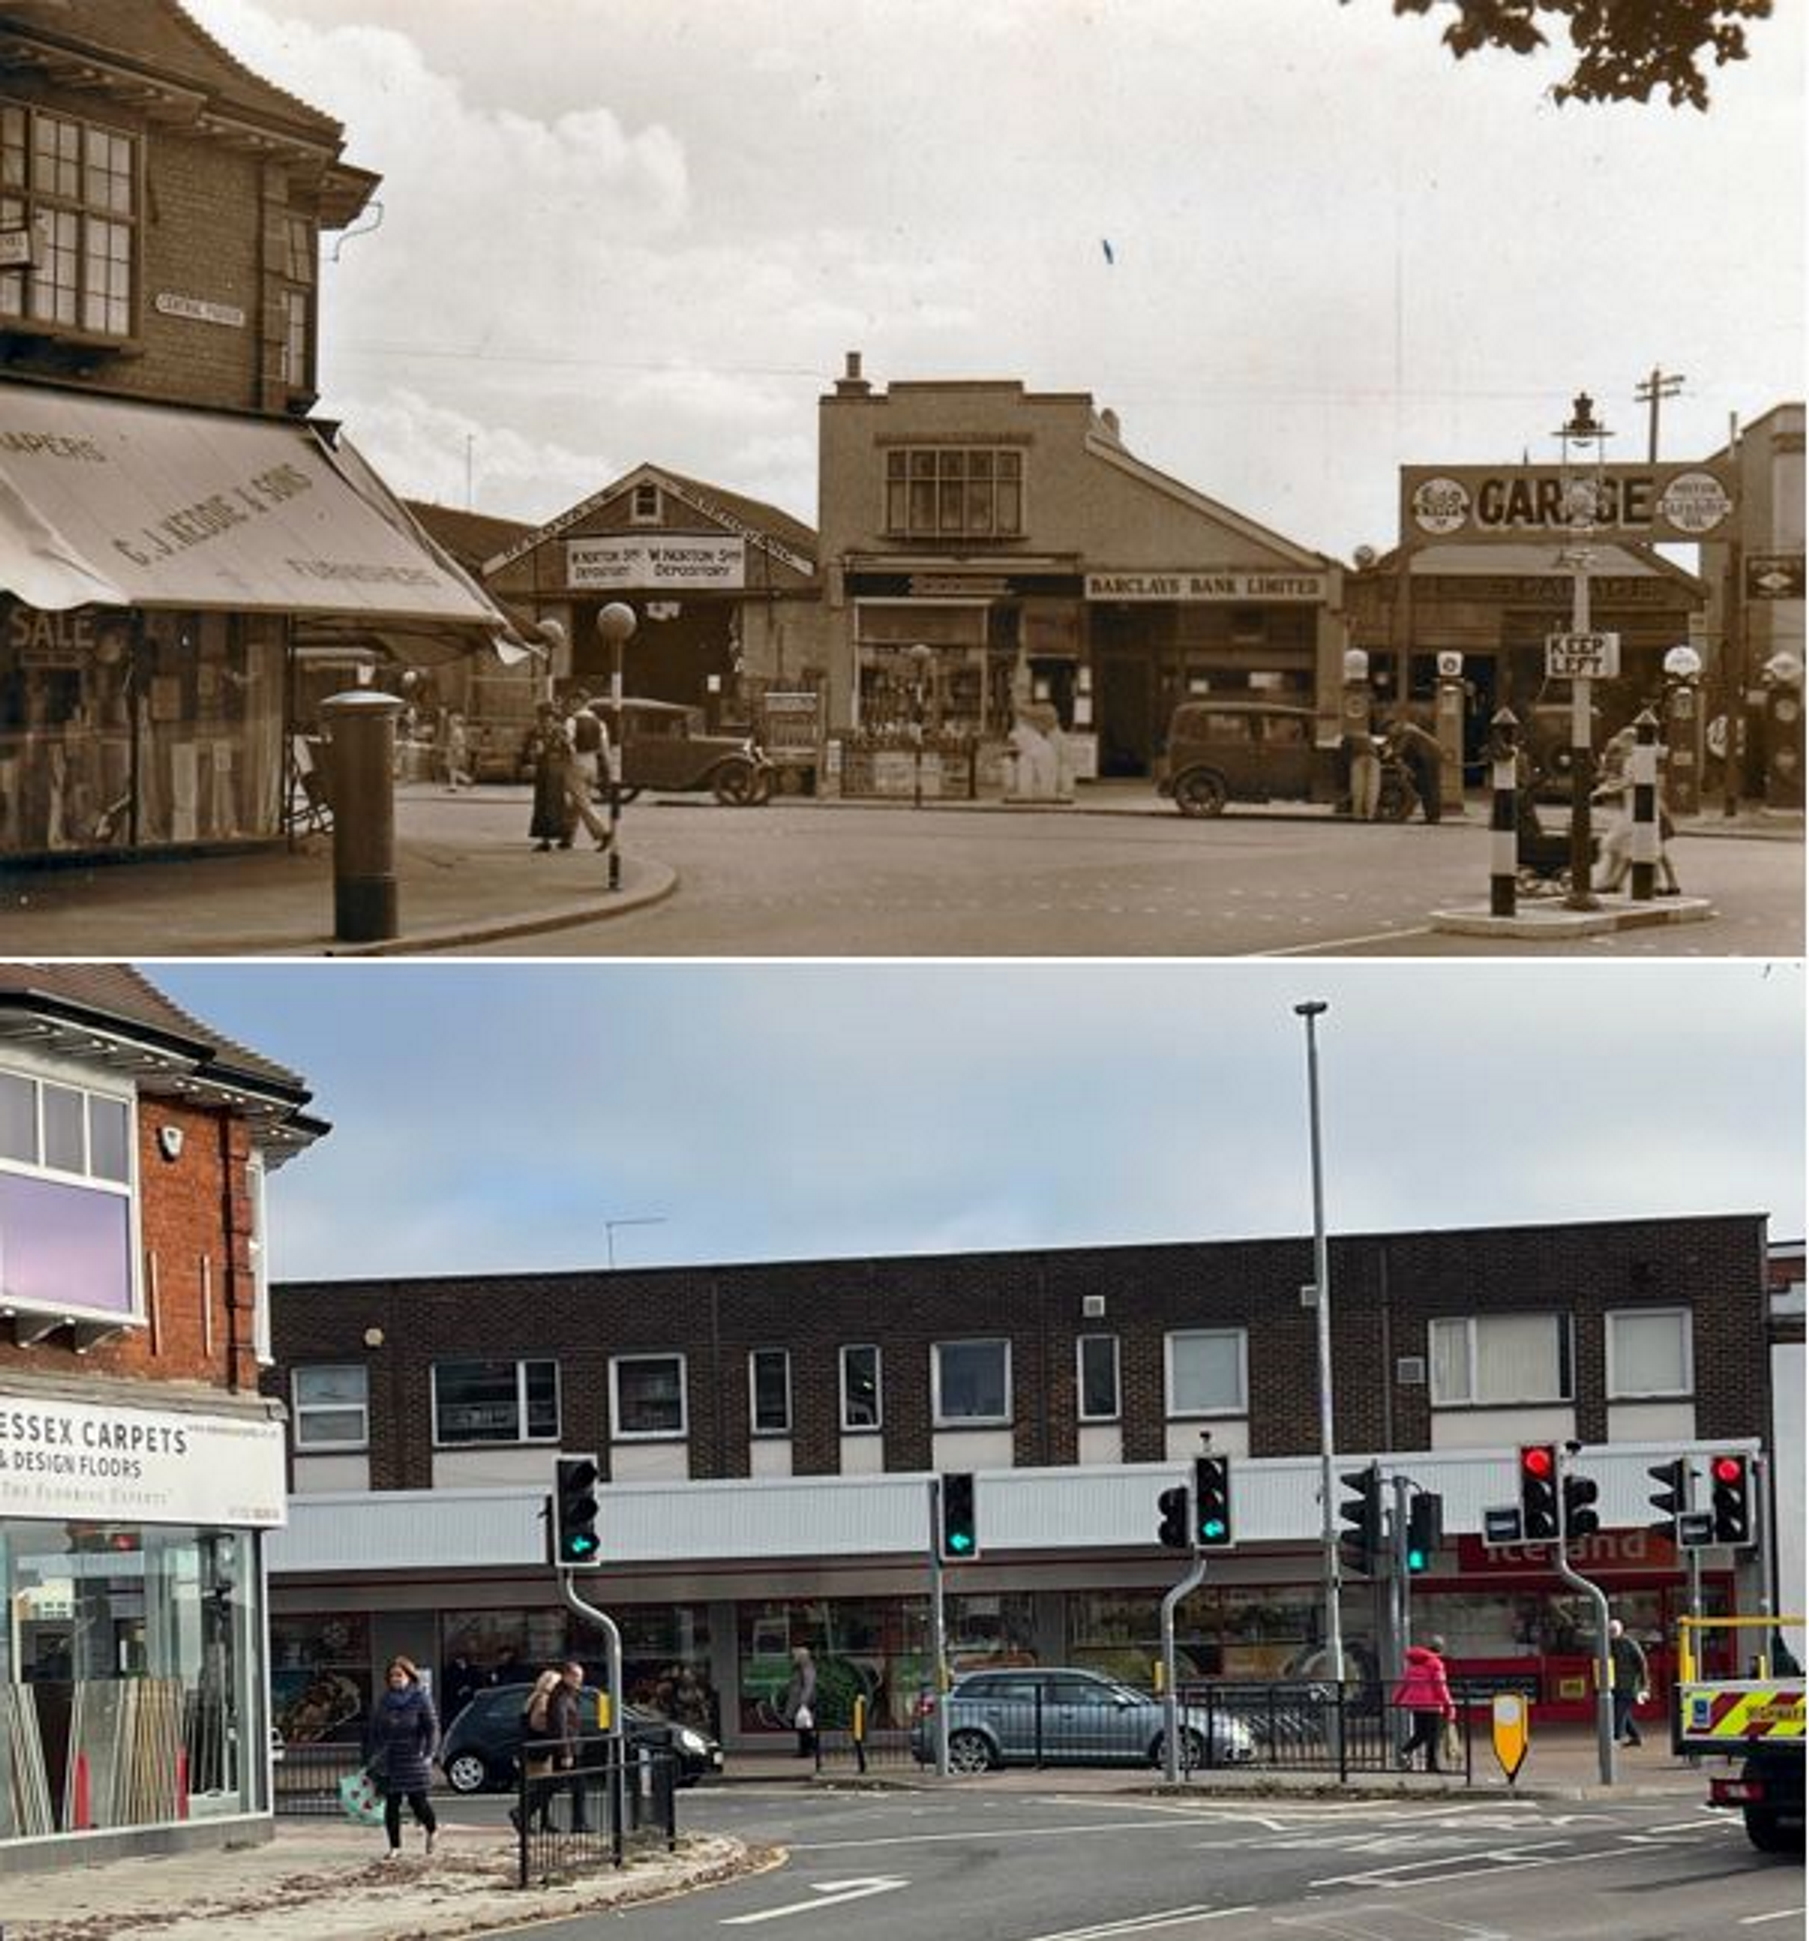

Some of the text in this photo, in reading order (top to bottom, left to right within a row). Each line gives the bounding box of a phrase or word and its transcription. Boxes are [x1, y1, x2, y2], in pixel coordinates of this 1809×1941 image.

[1479, 479, 1654, 525] GARGE
[1092, 578, 1320, 594] BARCLAYS BANK LIMITED
[9, 606, 95, 649] SALE
[1551, 639, 1604, 654] KEEP
[1551, 656, 1602, 674] LEFT
[83, 1421, 188, 1454] CARPETS
[14, 1451, 75, 1474] DESIGN
[80, 1455, 142, 1479] FLOORS
[1487, 1530, 1648, 1563] Iceand
